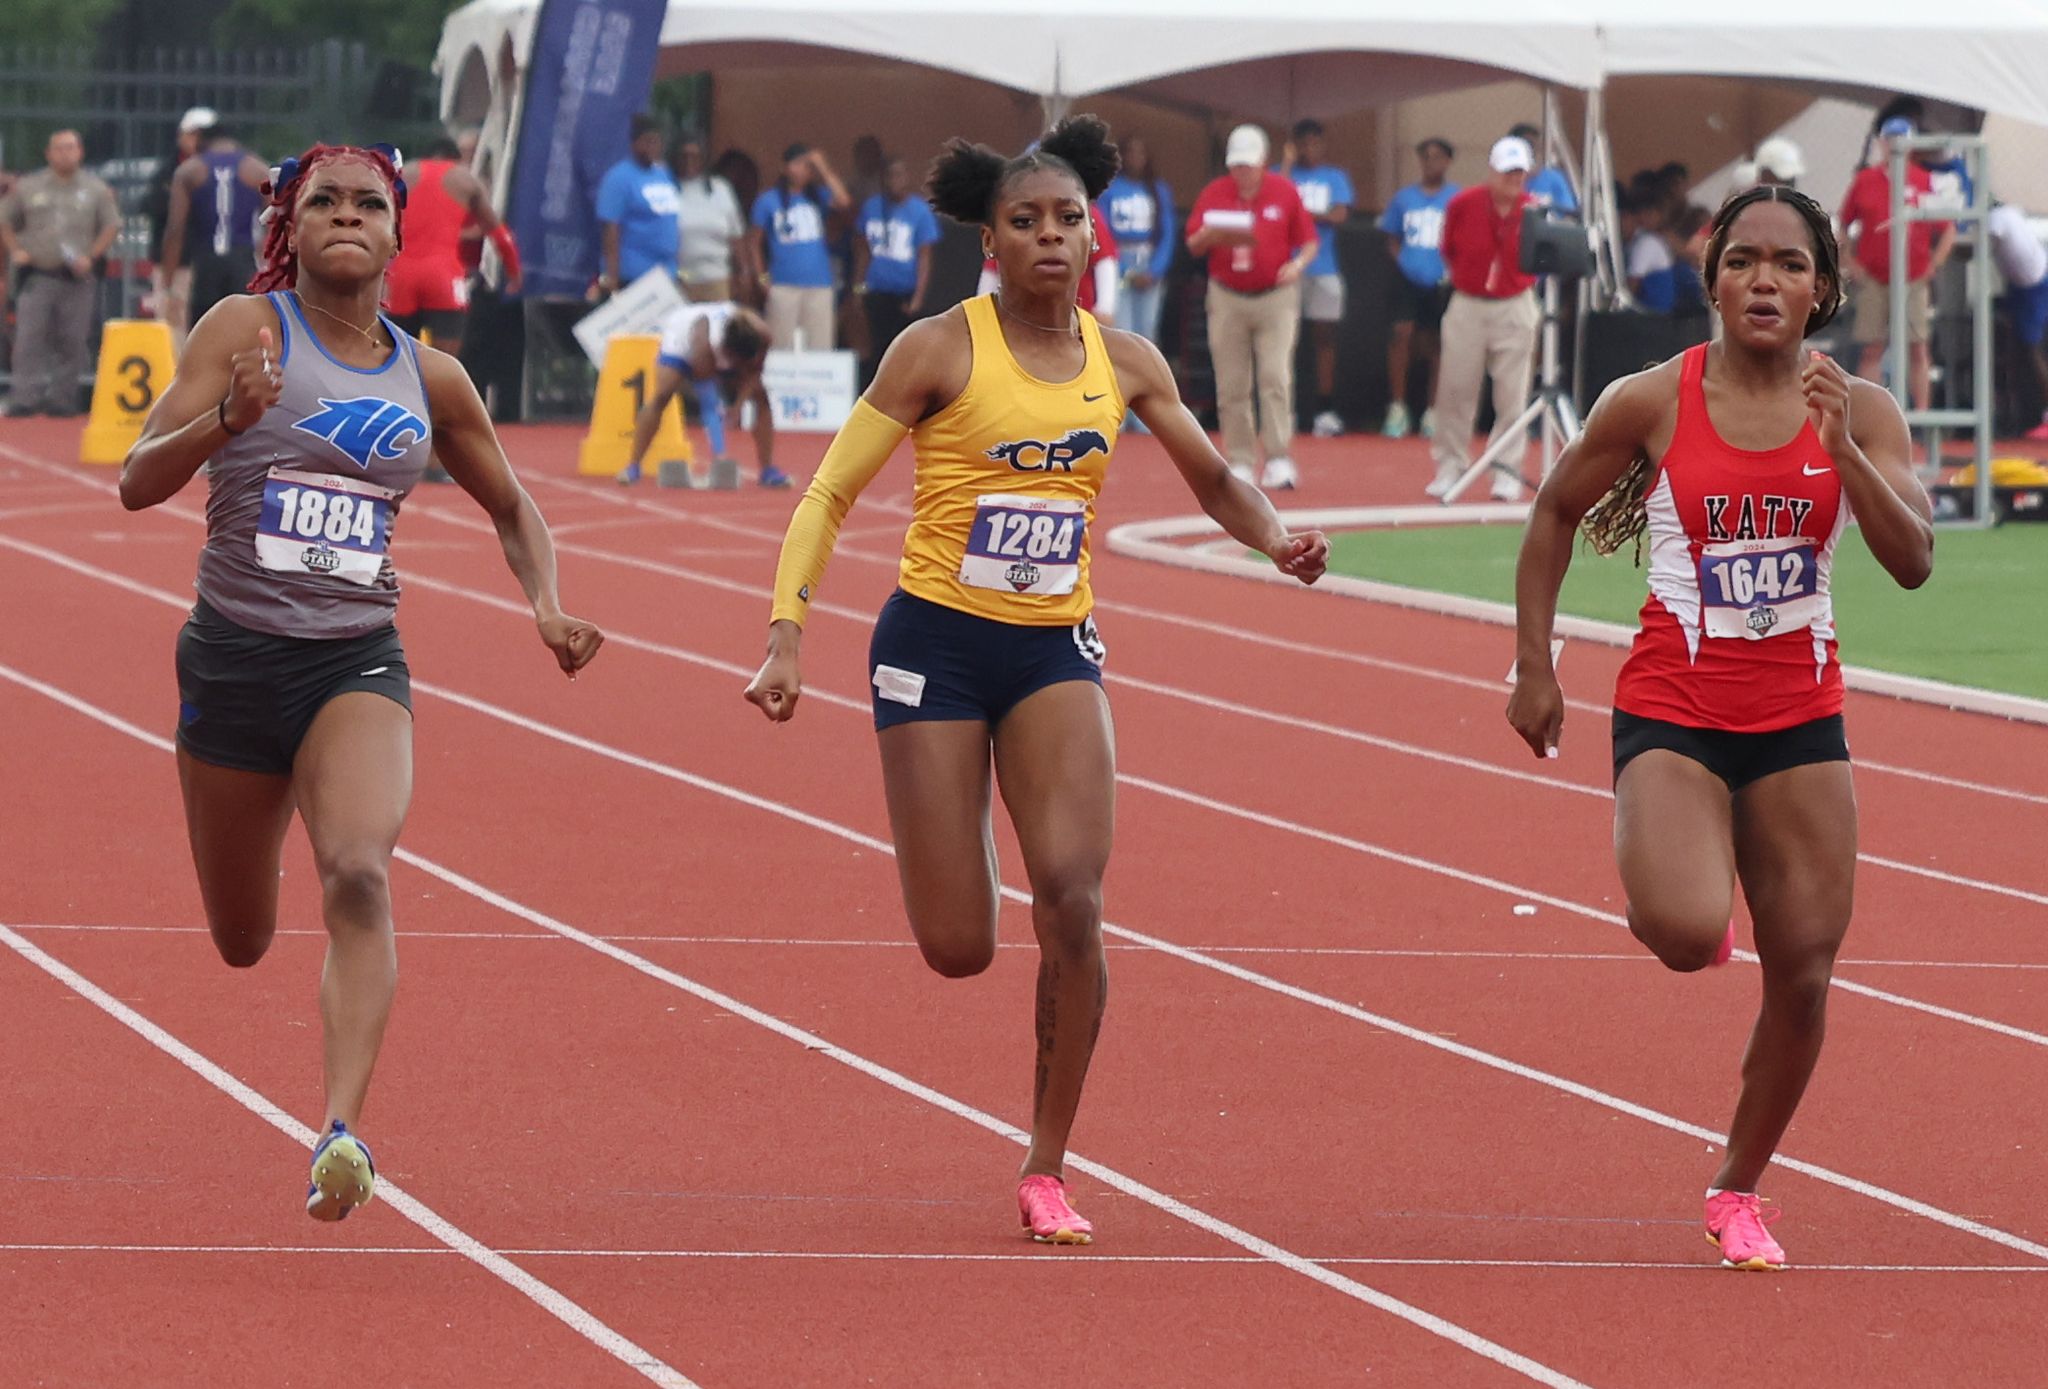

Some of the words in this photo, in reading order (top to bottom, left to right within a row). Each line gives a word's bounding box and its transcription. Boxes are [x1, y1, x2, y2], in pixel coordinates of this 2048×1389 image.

[116, 355, 153, 412] 3
[1008, 440, 1073, 472] CR
[277, 487, 375, 547] 1884
[1028, 501, 1048, 510] 2024
[1704, 494, 1812, 541] KATY
[986, 511, 1074, 560] 1284
[1743, 544, 1765, 552] 2024
[301, 552, 341, 569] STATE
[1005, 569, 1041, 583] STATE
[1711, 552, 1804, 604] 1642
[1746, 613, 1778, 628] STATE
